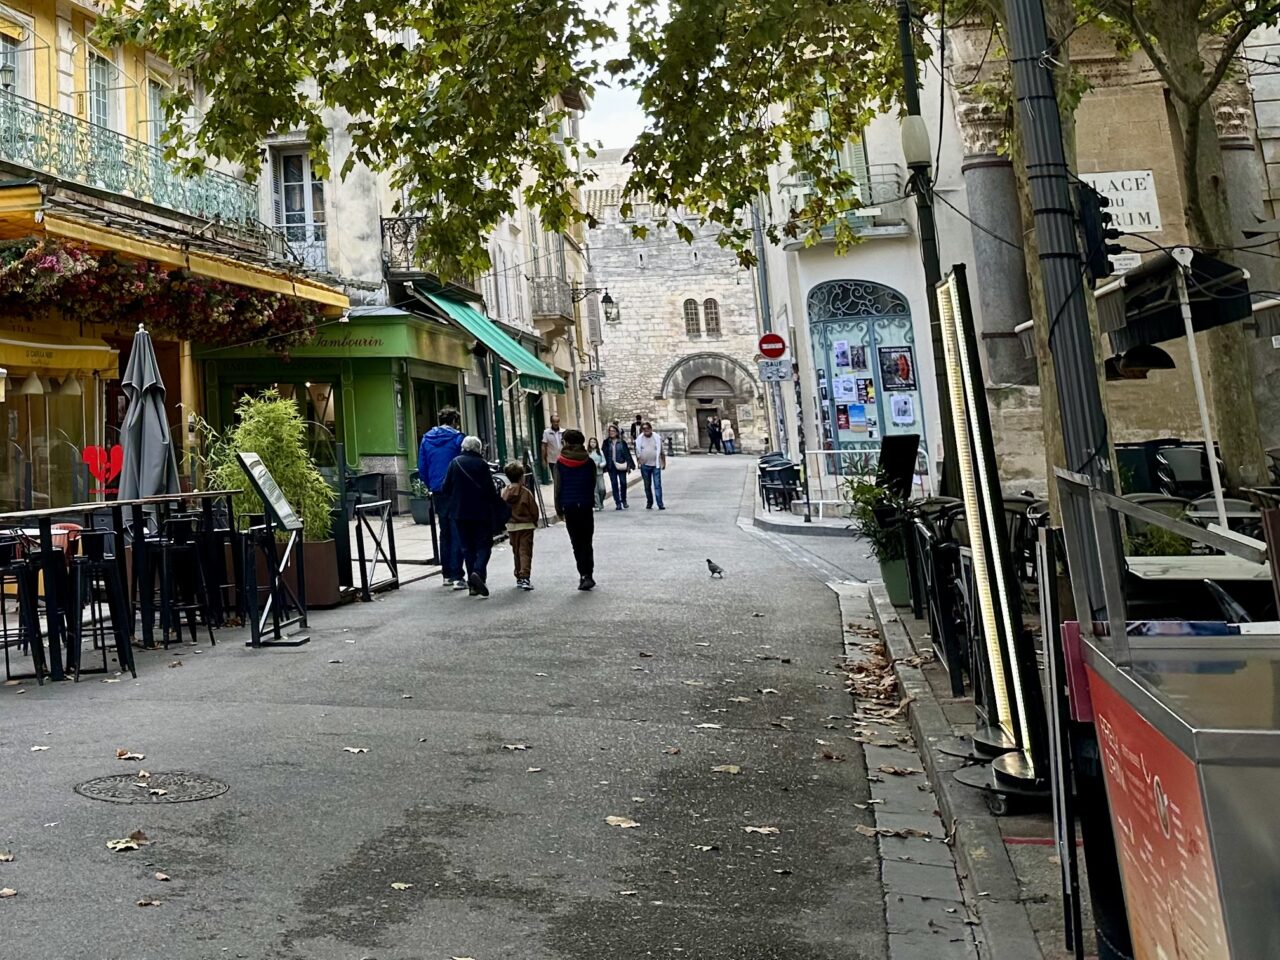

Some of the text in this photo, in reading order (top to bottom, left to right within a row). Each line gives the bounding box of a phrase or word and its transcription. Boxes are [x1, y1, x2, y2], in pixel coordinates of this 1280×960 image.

[1086, 177, 1147, 193] LACE
[1109, 211, 1152, 227] RUM
[315, 330, 384, 349] Tambourin
[765, 360, 783, 368] SAUF
